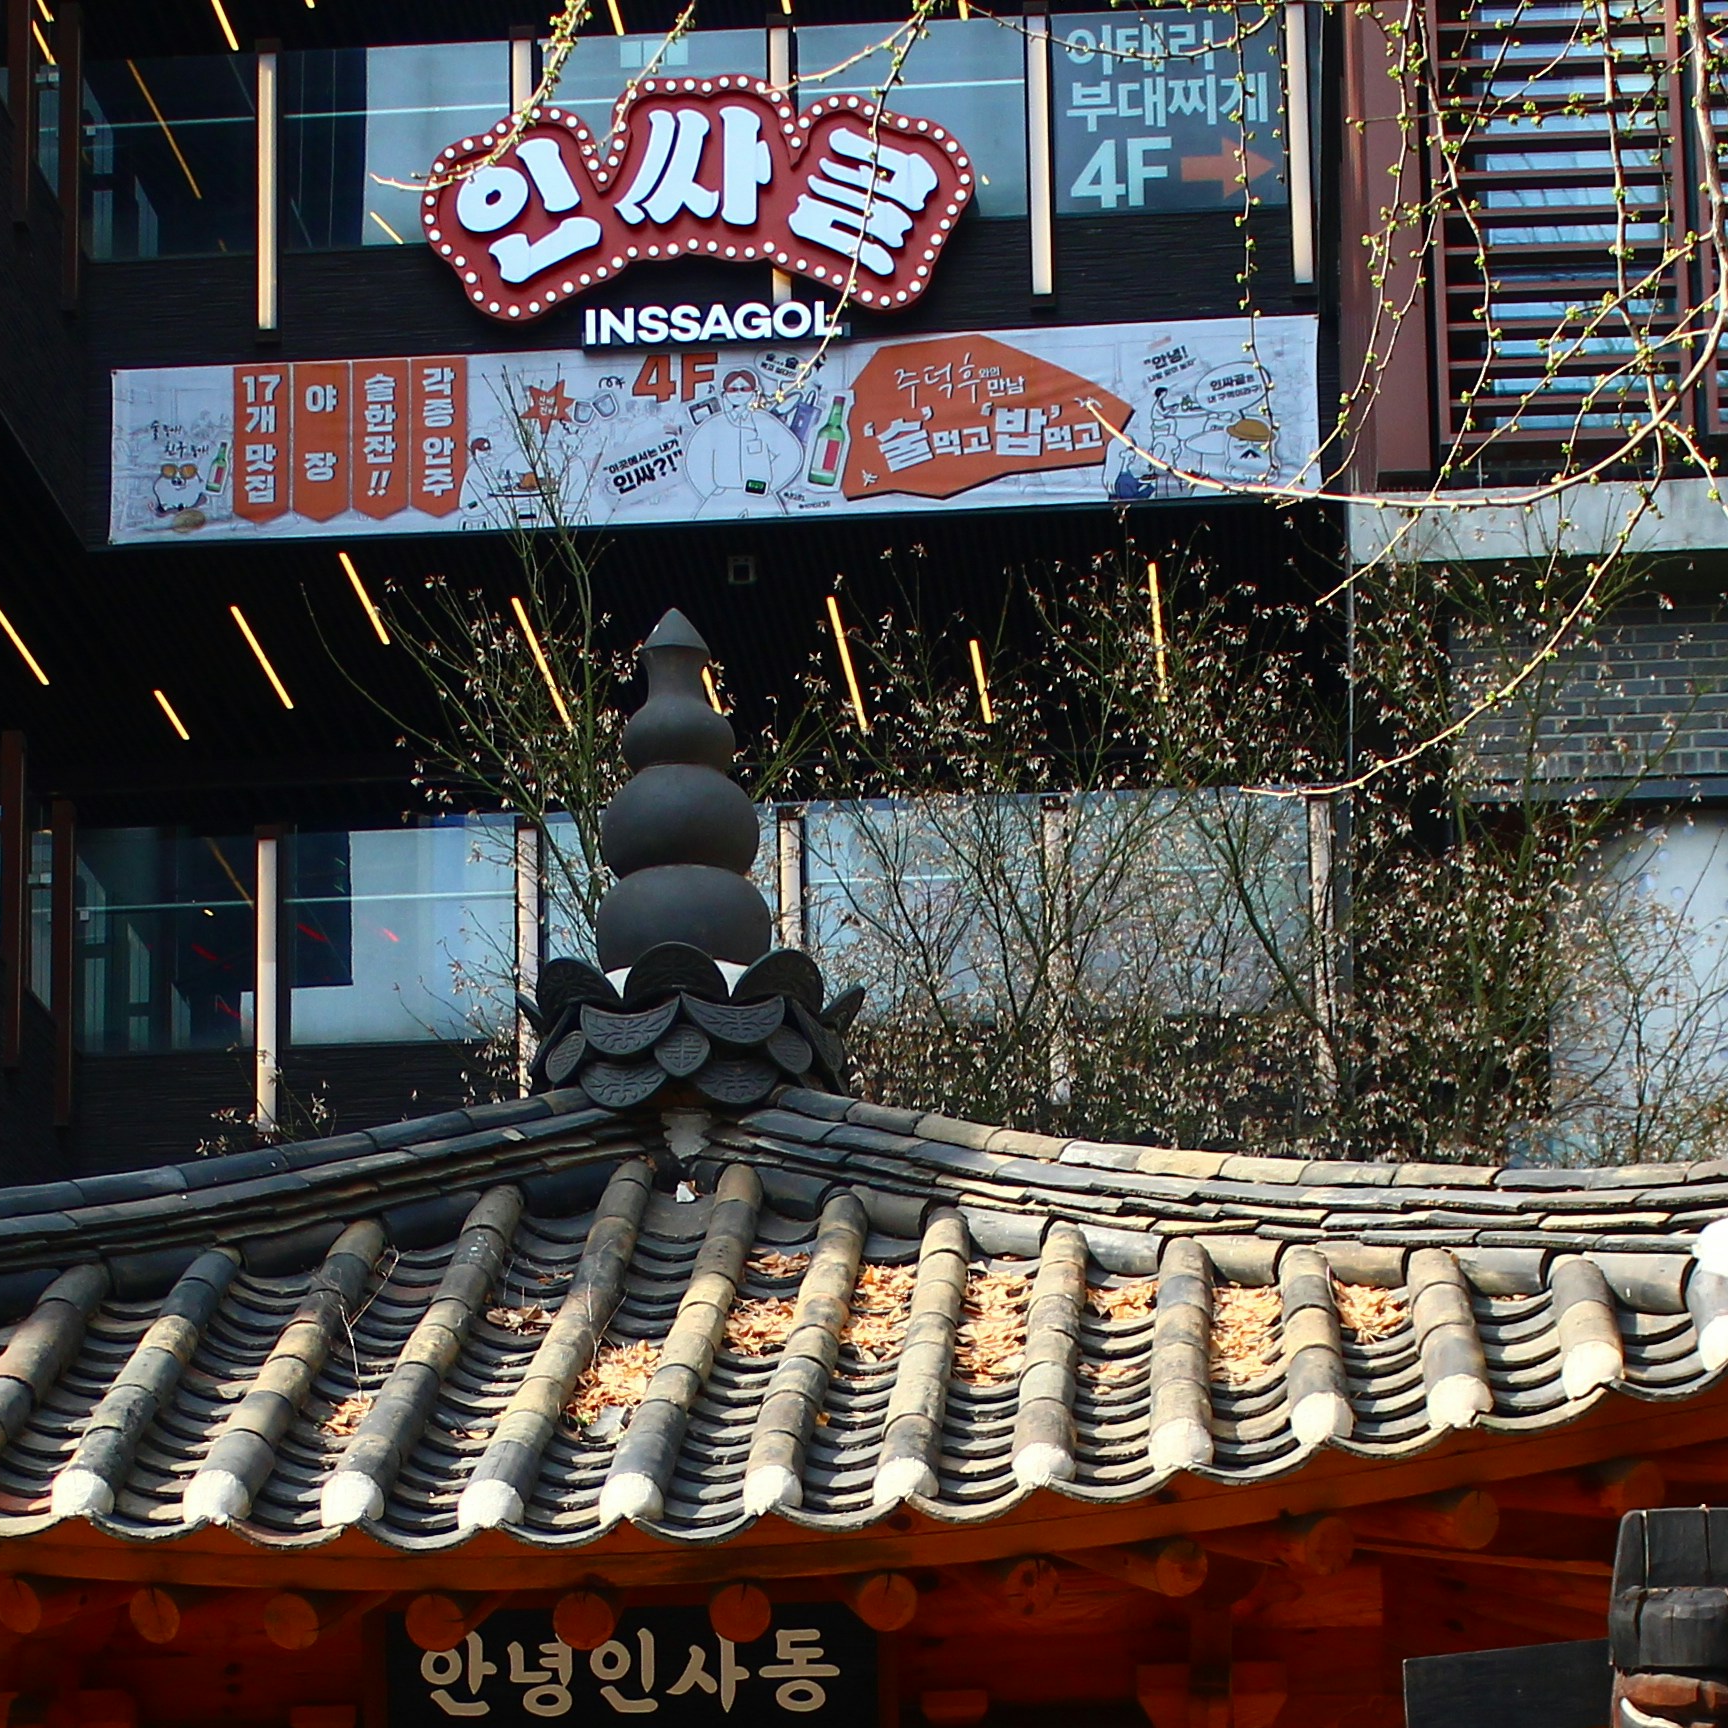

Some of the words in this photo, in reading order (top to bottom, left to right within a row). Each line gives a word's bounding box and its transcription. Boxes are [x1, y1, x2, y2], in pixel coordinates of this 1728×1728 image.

[1066, 19, 1215, 76] 이태리
[455, 105, 940, 284] 인싸골
[1070, 135, 1173, 209] 4F
[584, 300, 843, 346] INSSAGOL
[241, 373, 282, 435] 17개
[422, 366, 456, 429] 각종
[631, 351, 718, 403] 4F
[986, 375, 1025, 398] 만남
[244, 443, 278, 504] 맛집
[421, 435, 456, 498] 안주
[420, 1627, 841, 1717] 안녕인사동
